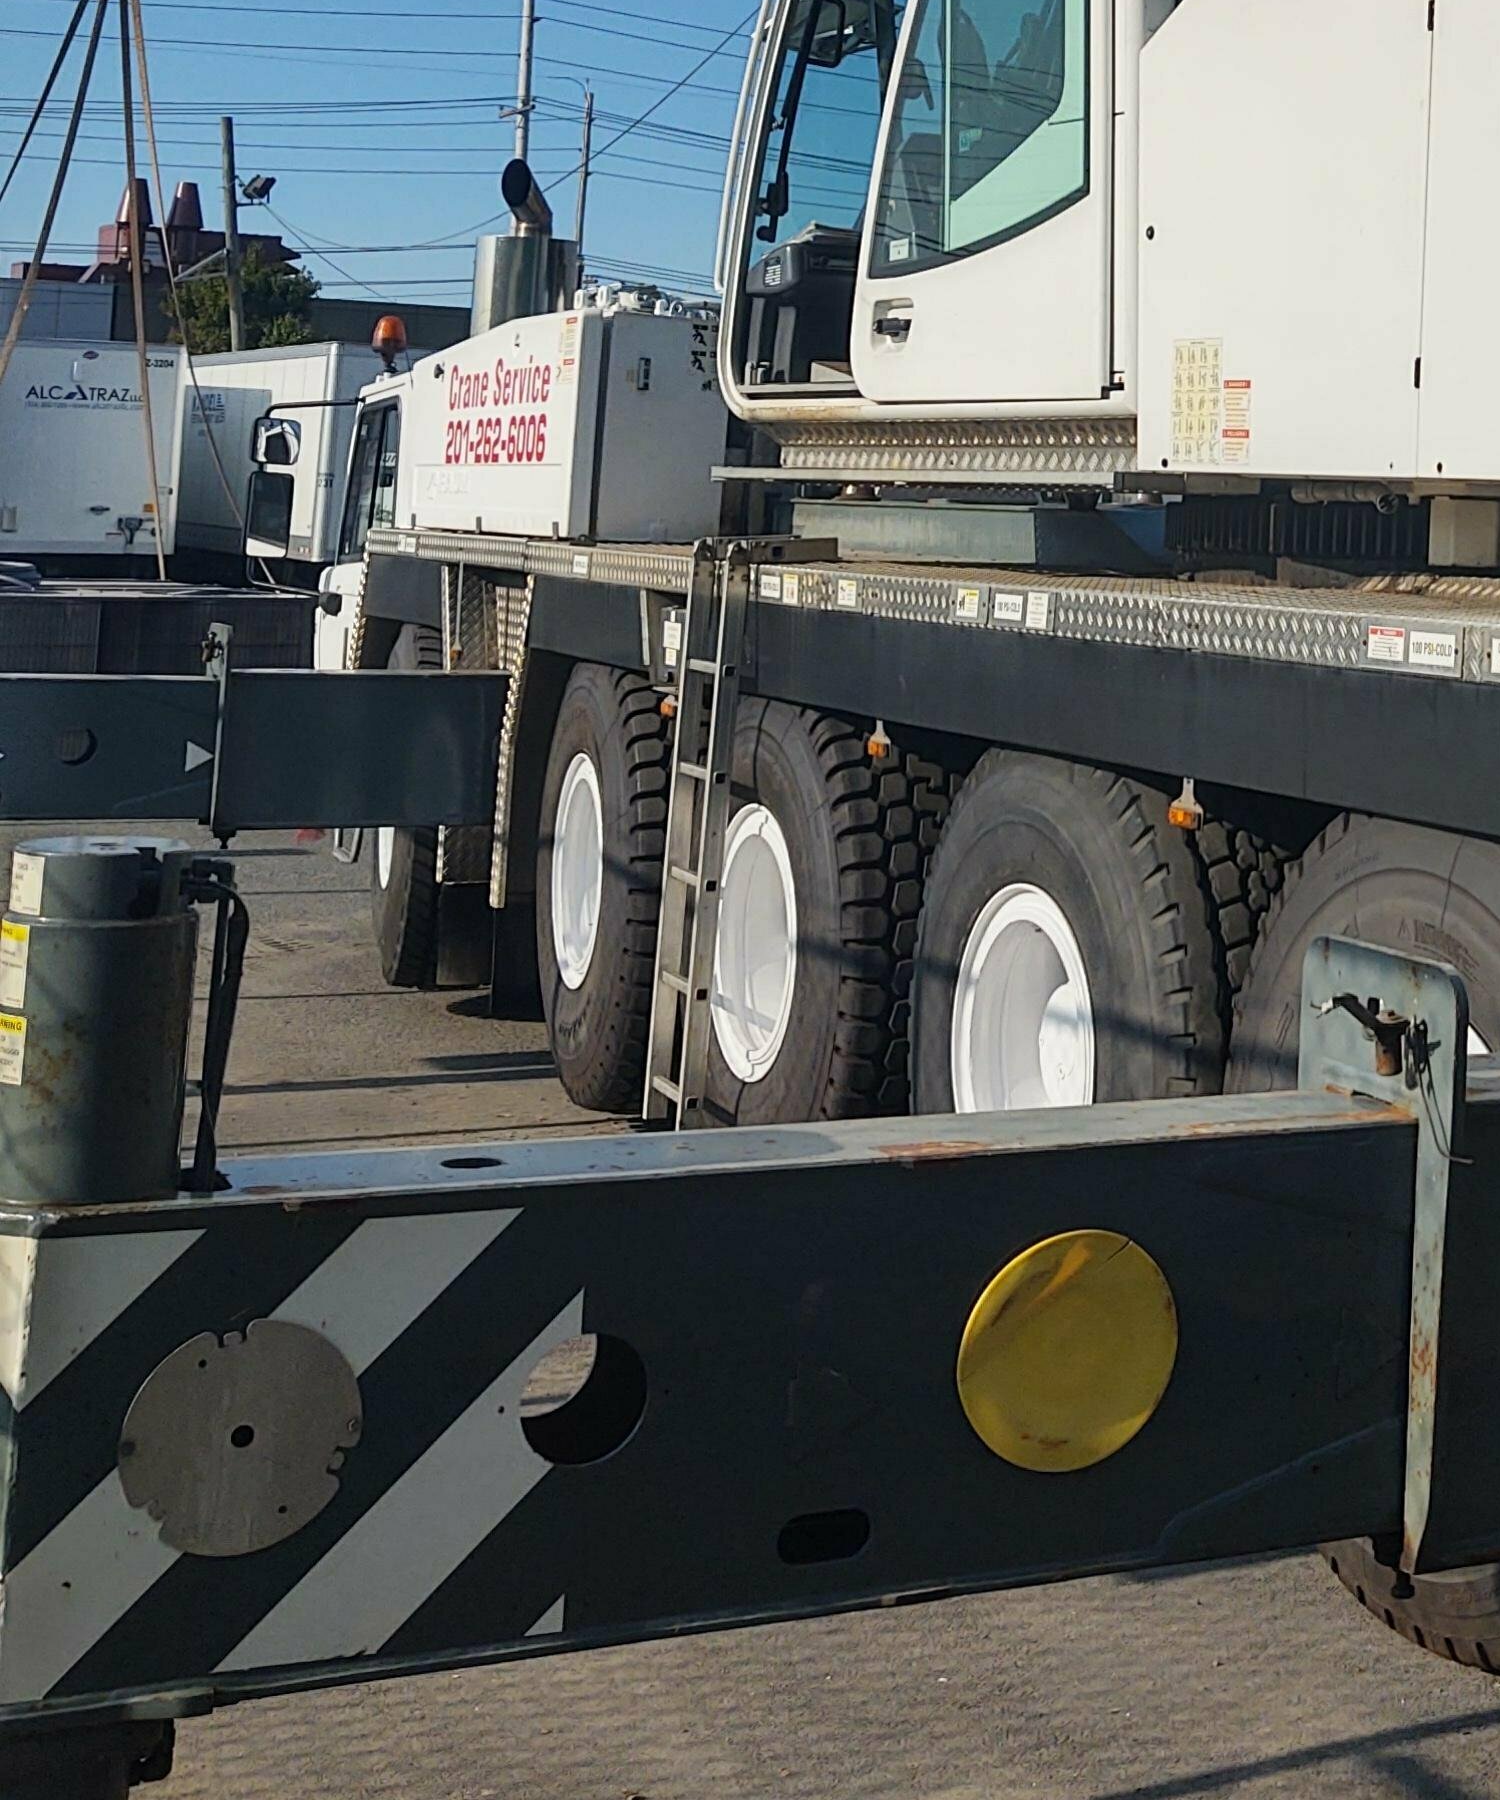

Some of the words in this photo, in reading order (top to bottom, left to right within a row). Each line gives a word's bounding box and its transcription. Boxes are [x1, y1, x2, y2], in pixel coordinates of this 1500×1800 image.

[25, 384, 131, 402] ALCATRAZ
[449, 364, 489, 410] Crane
[493, 354, 551, 406] Service
[445, 413, 547, 464] 201-262-6006
